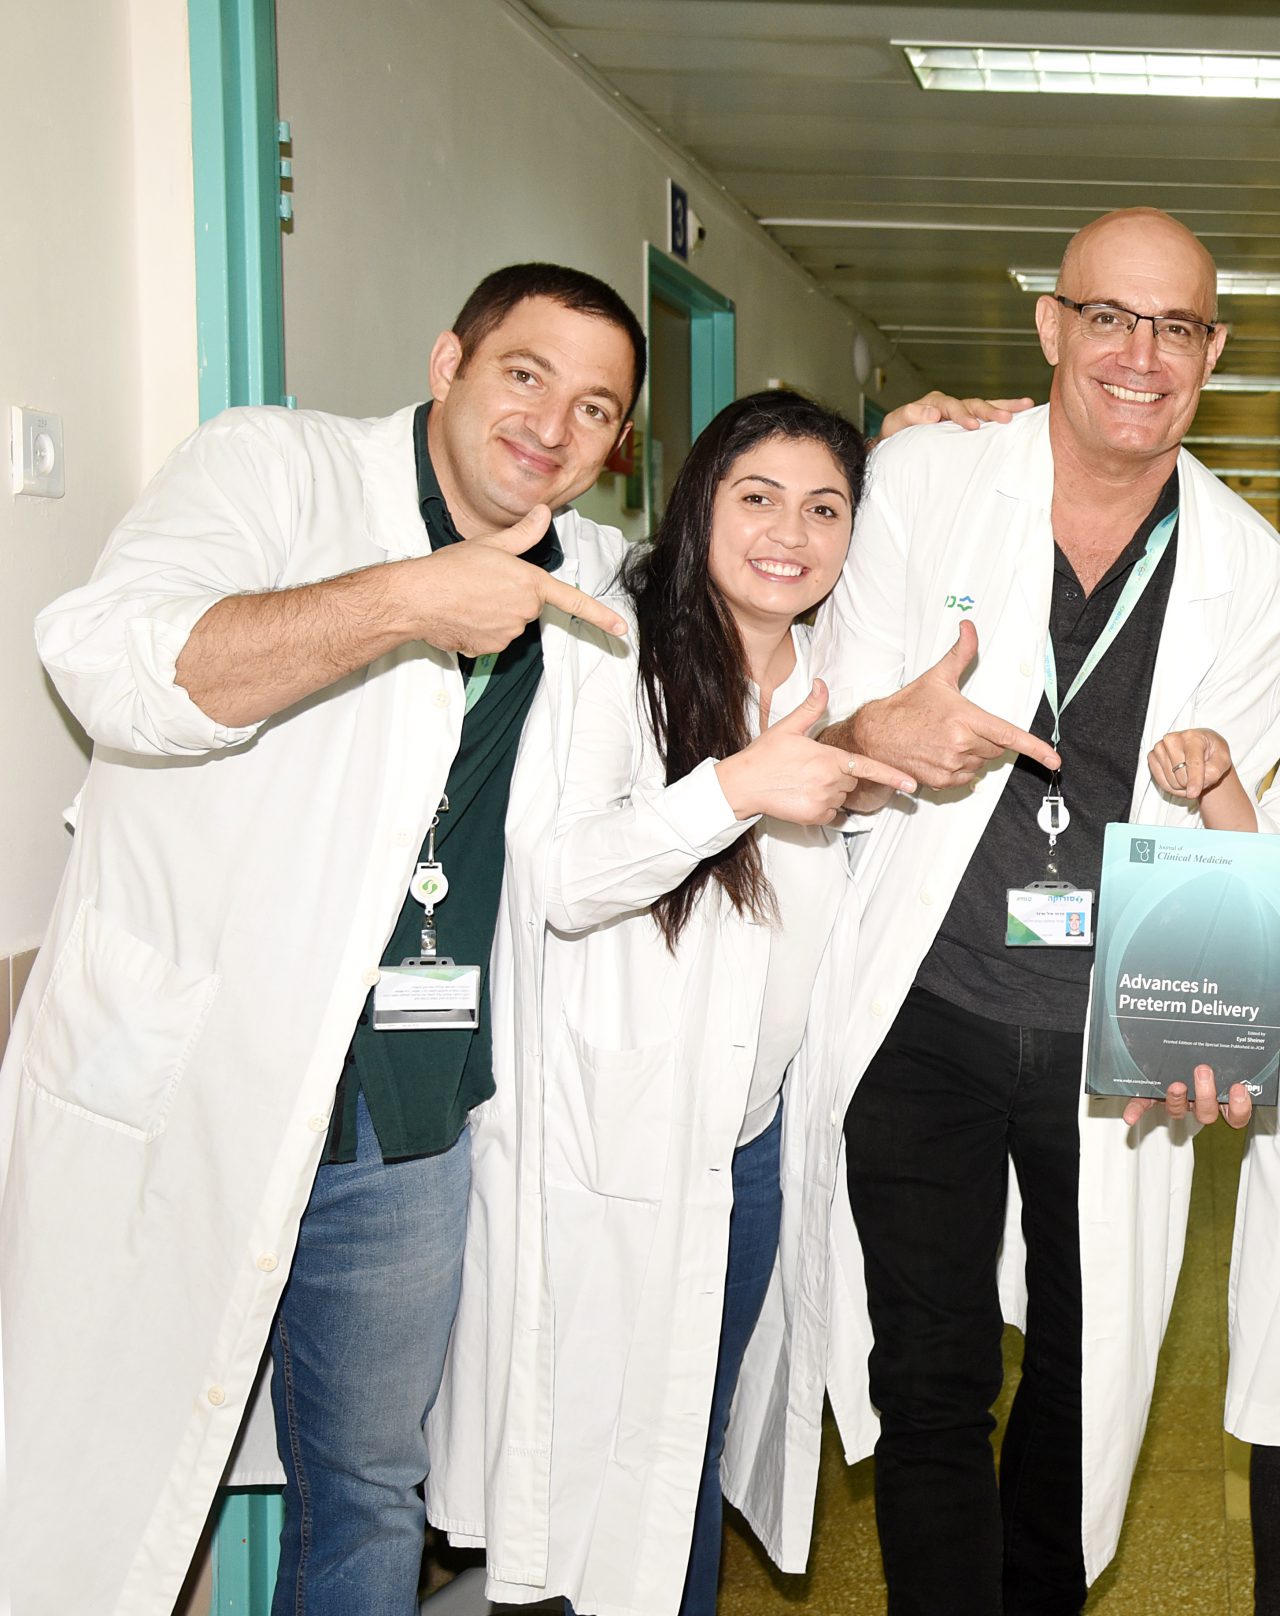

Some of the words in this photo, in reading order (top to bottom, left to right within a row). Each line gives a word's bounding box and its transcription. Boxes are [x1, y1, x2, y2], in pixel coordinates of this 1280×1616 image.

[1157, 852, 1192, 862] Clinical
[1193, 854, 1233, 865] Medicine
[1119, 973, 1199, 994] Advances
[1203, 978, 1218, 994] in
[1118, 994, 1187, 1013] Preterm
[1191, 999, 1260, 1022] Delivery
